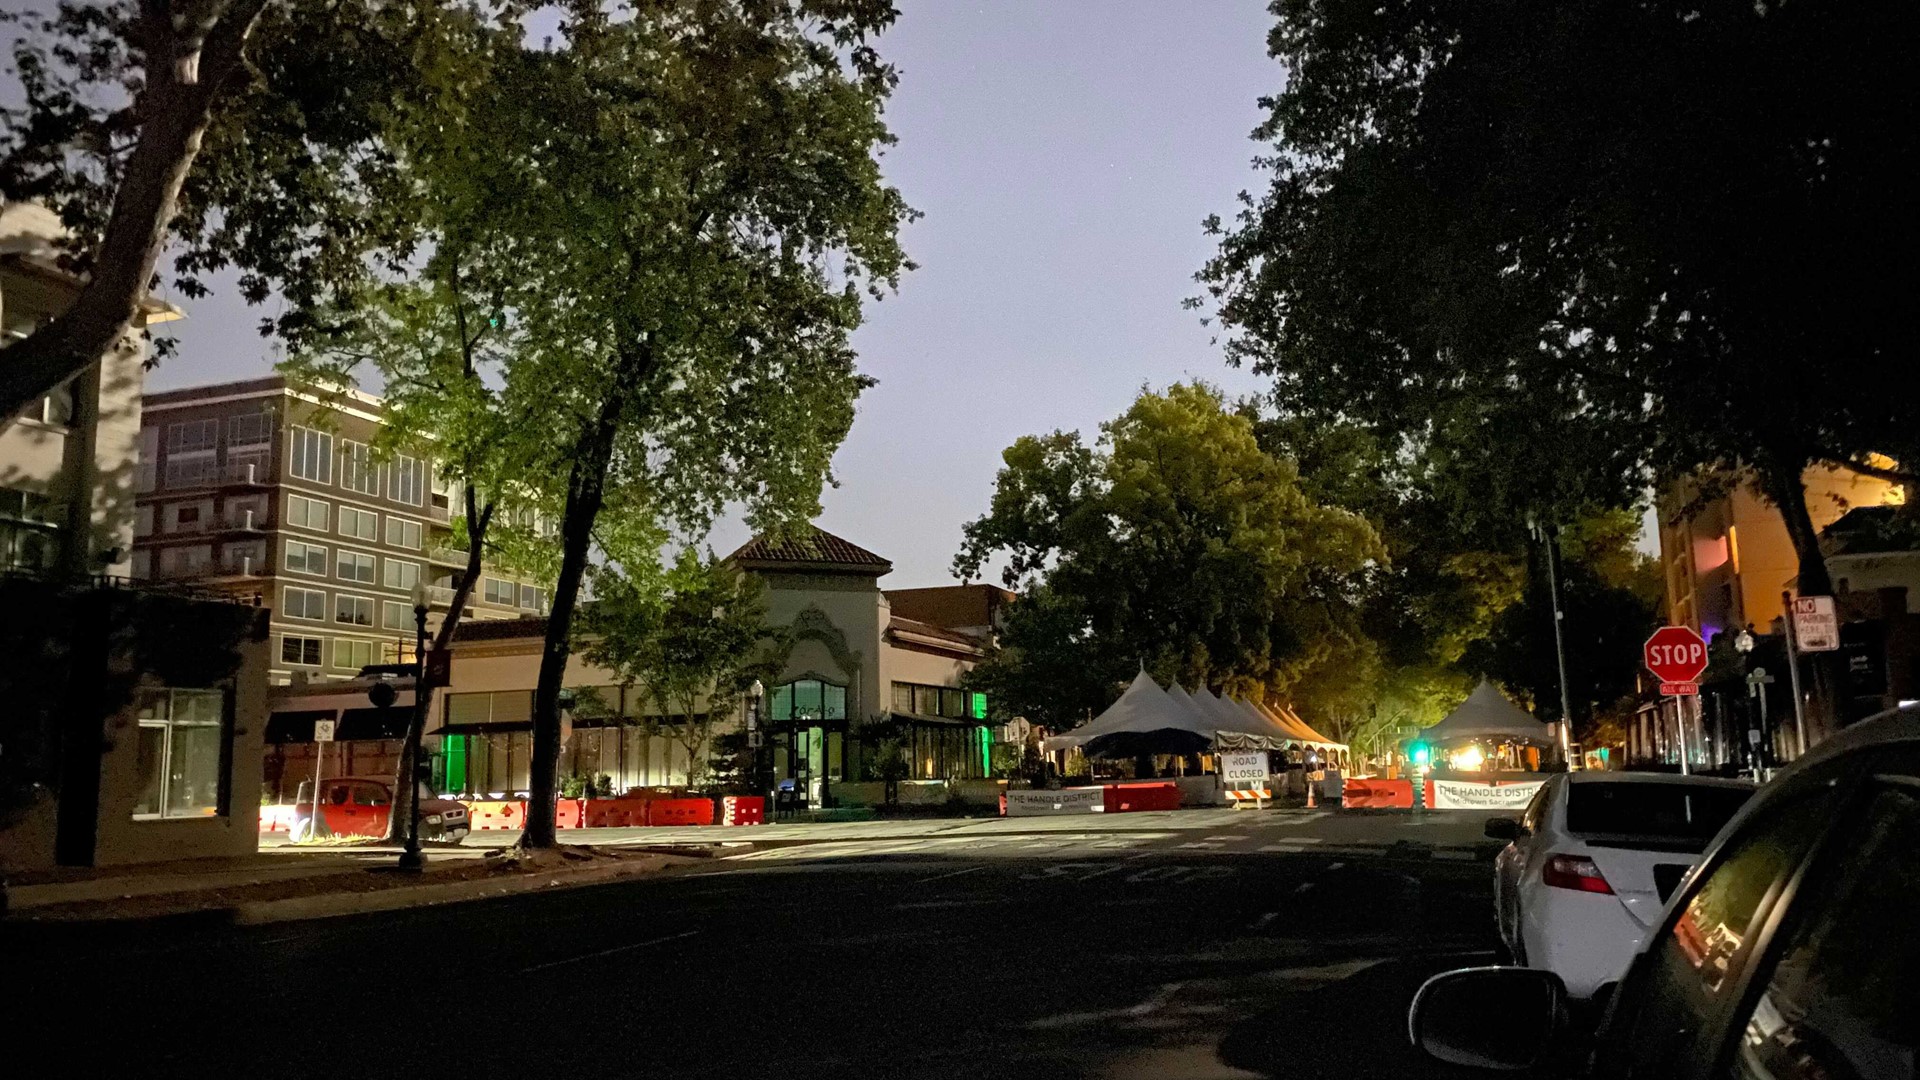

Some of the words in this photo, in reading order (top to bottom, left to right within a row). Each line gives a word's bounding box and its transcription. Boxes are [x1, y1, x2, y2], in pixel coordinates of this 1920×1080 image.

[1797, 599, 1815, 613] NO
[1650, 643, 1702, 666] STOP
[1662, 685, 1676, 693] ALL
[1678, 685, 1696, 693] WAY
[1232, 756, 1257, 766] ROAD
[1228, 769, 1264, 779] CLOSED
[1438, 783, 1457, 795] THE
[1460, 786, 1501, 797] HANDLE
[1504, 786, 1537, 797] DISTRI
[1009, 794, 1025, 804] THE
[1027, 794, 1062, 803] HANDLE
[1063, 791, 1101, 803] DISTRICT
[1453, 798, 1487, 806] Midtown
